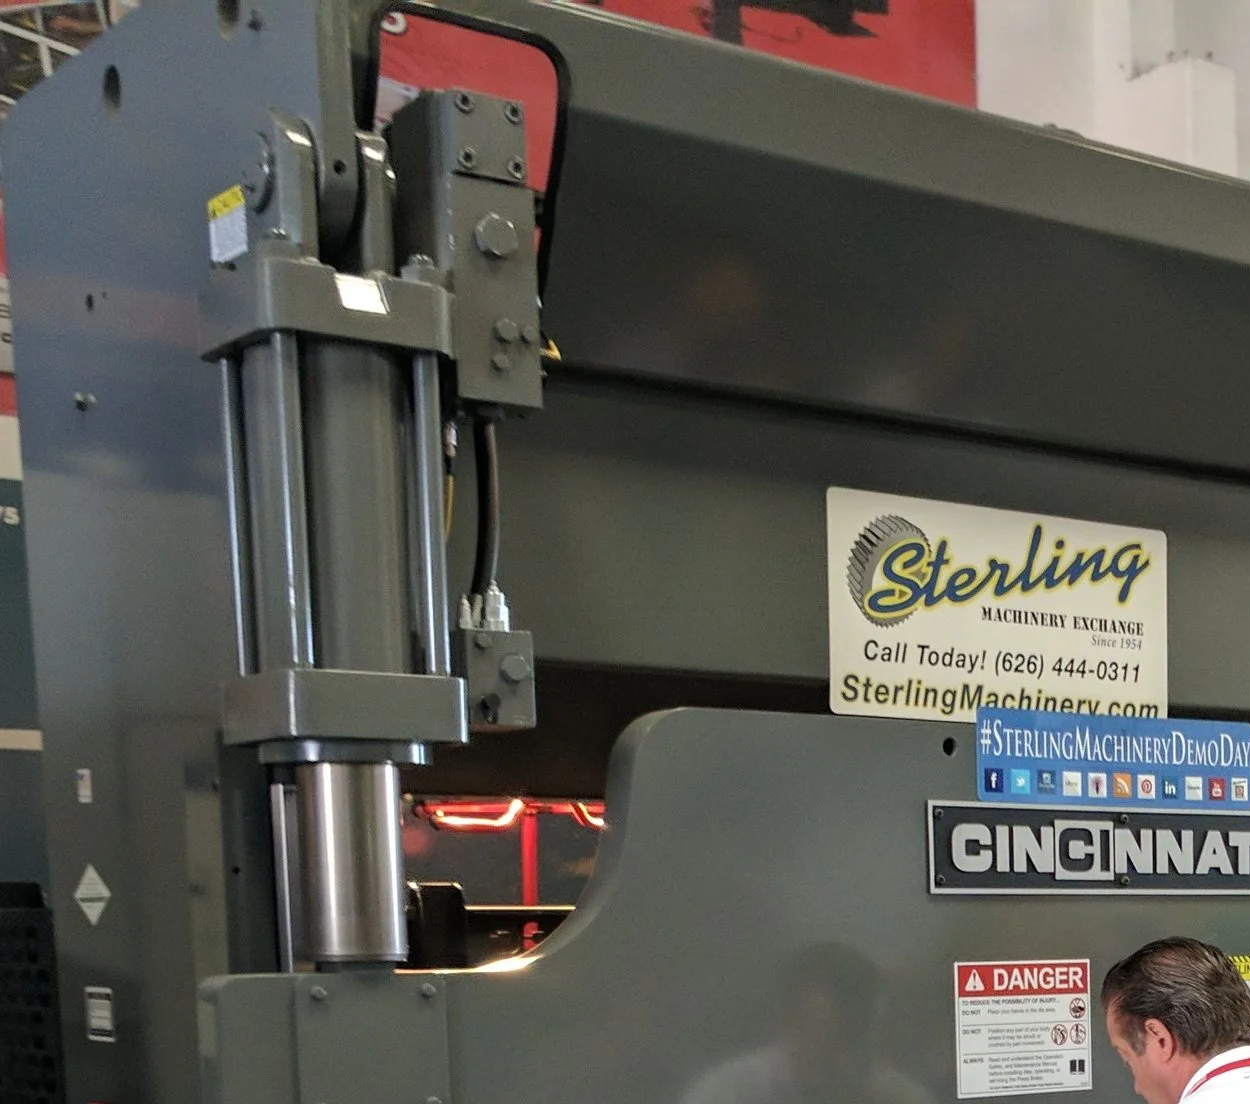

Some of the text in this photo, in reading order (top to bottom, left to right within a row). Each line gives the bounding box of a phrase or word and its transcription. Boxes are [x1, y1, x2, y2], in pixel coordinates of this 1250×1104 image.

[867, 524, 1151, 615] Sterling
[981, 606, 1145, 637] MACHINERY EXCHANGE
[1091, 635, 1142, 650] Since 1954
[864, 640, 1140, 683] Call Today! (626) 444-0311
[993, 967, 1085, 991] DANGER
